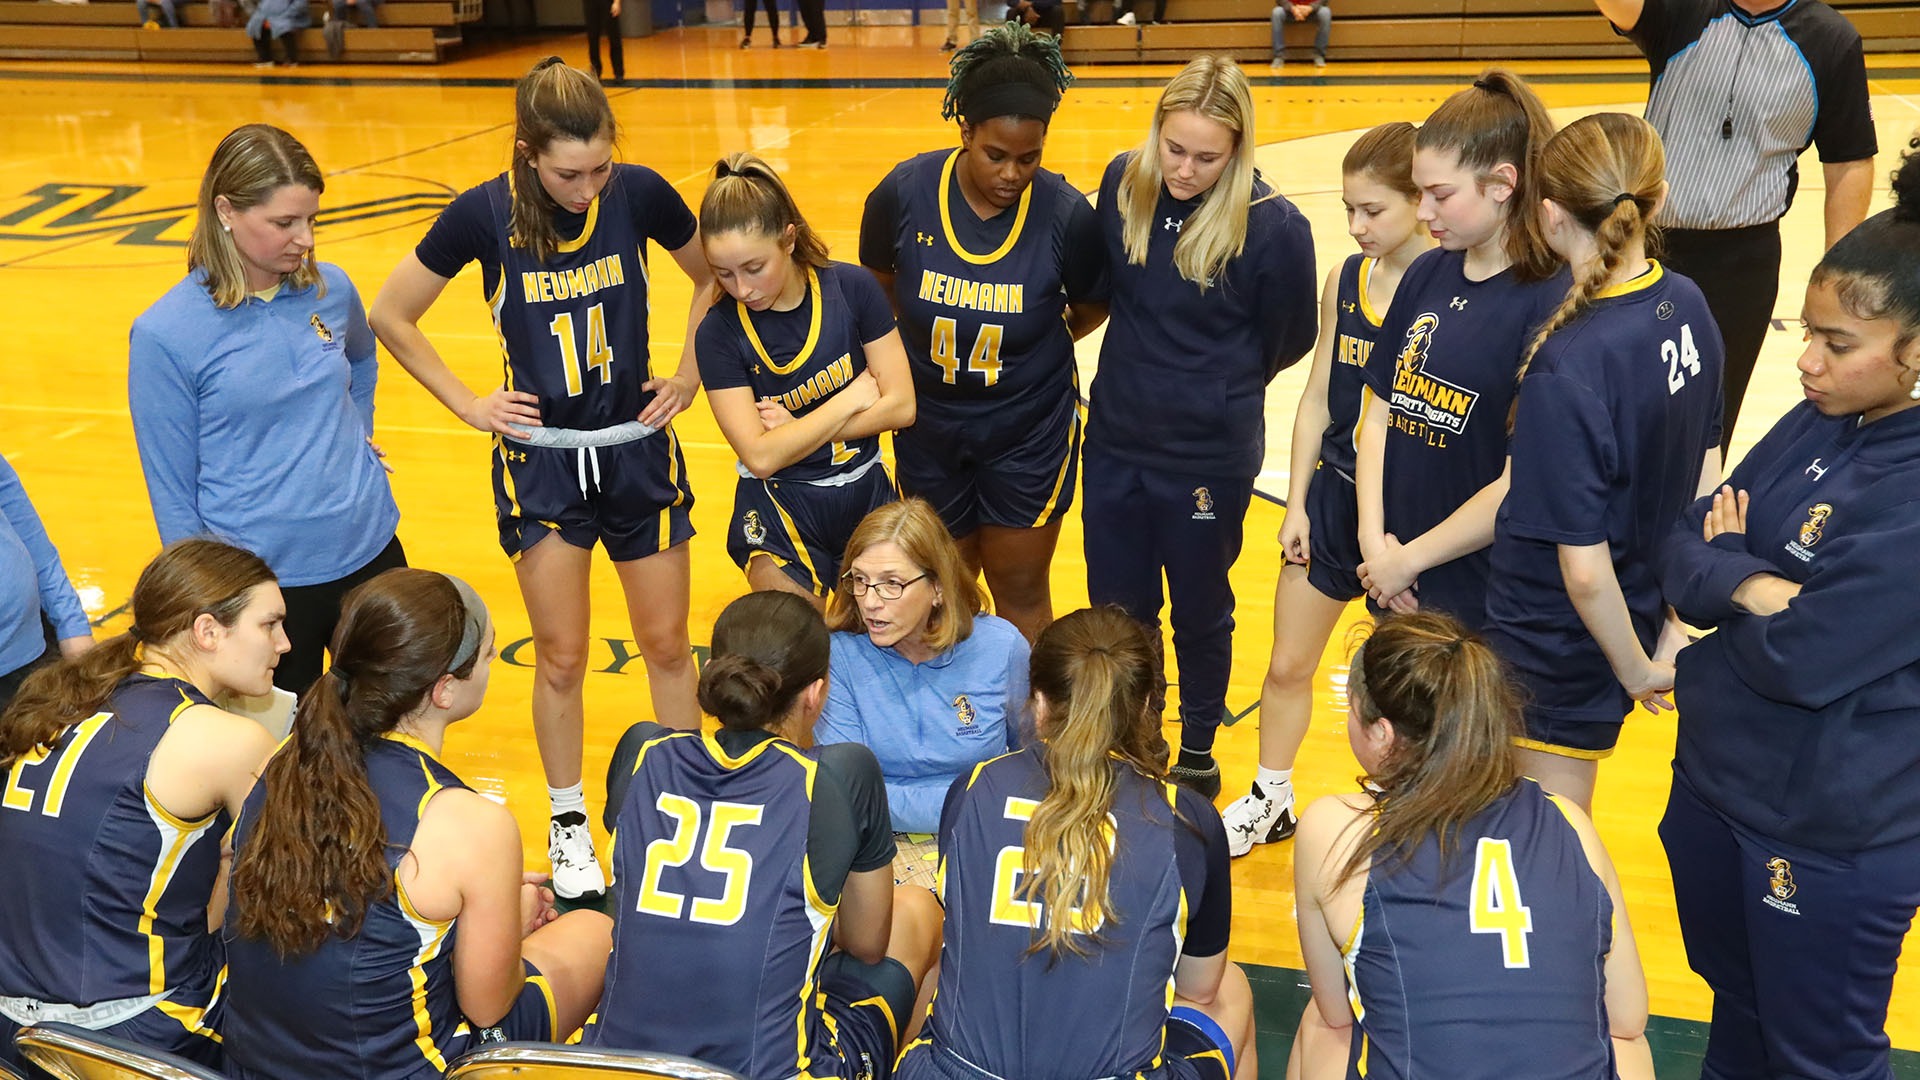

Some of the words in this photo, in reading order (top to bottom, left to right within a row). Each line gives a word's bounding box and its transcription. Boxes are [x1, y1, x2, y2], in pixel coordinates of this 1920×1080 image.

[521, 254, 624, 303] NEUMANN
[919, 269, 1023, 313] NEUMANN
[549, 302, 614, 398] 14
[761, 353, 853, 411] UMANN
[930, 316, 1004, 387] 44
[1338, 334, 1375, 368] NEU
[1661, 323, 1701, 395] 24
[1395, 359, 1471, 415] EUMANN
[2, 711, 114, 818] 21
[636, 791, 765, 927] 25
[1469, 837, 1533, 969] 4
